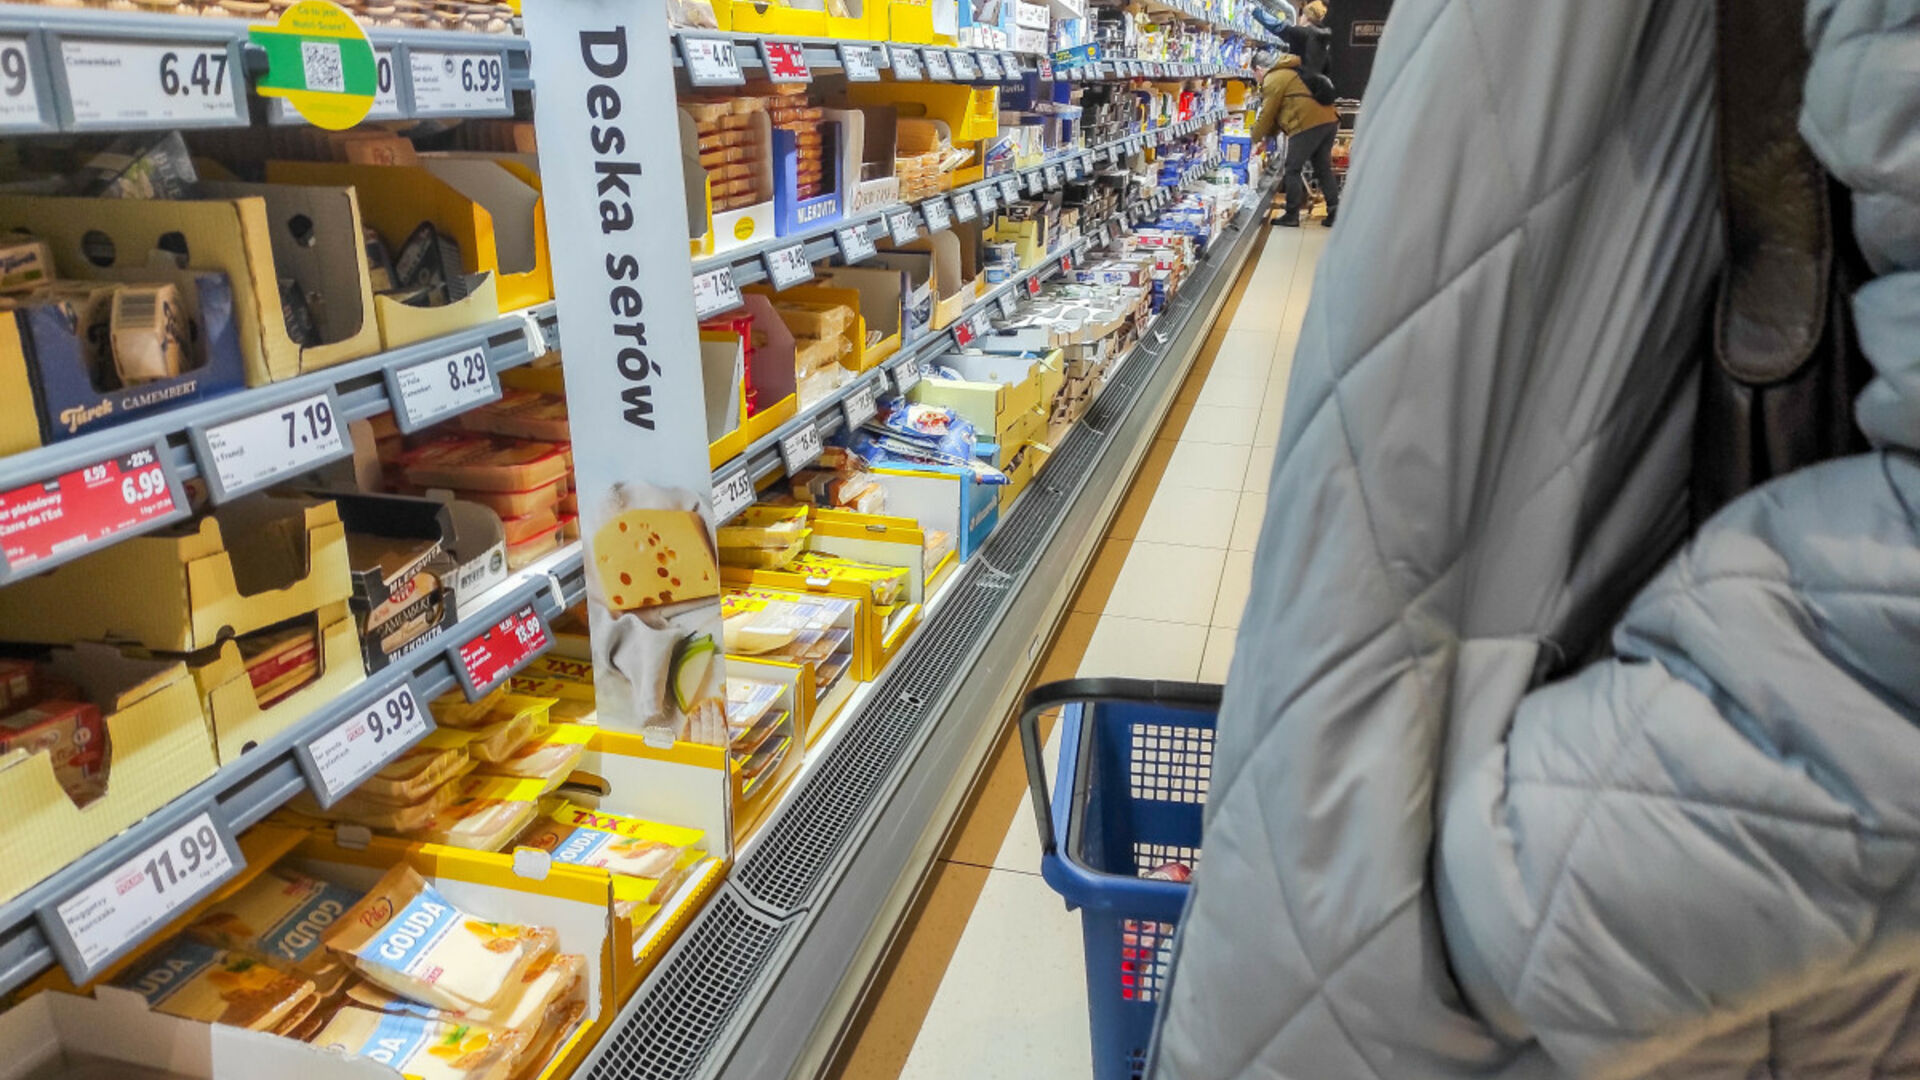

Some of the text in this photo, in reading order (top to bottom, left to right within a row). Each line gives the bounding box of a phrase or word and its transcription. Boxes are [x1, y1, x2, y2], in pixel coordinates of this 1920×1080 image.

[160, 52, 228, 97] 6.47
[461, 58, 501, 92] 6.99
[579, 26, 663, 432] Deska serów
[447, 352, 486, 391] 8.29
[60, 380, 197, 433] Turek CAMEMBERT
[281, 402, 334, 449] 7.19
[127, 450, 154, 468] -22%
[122, 468, 165, 504] 6.99
[515, 616, 540, 644] 13.99
[366, 690, 415, 743] 9.99
[144, 824, 218, 894] 11.99
[559, 832, 602, 862] OUDA
[379, 901, 447, 961] GOUDA
